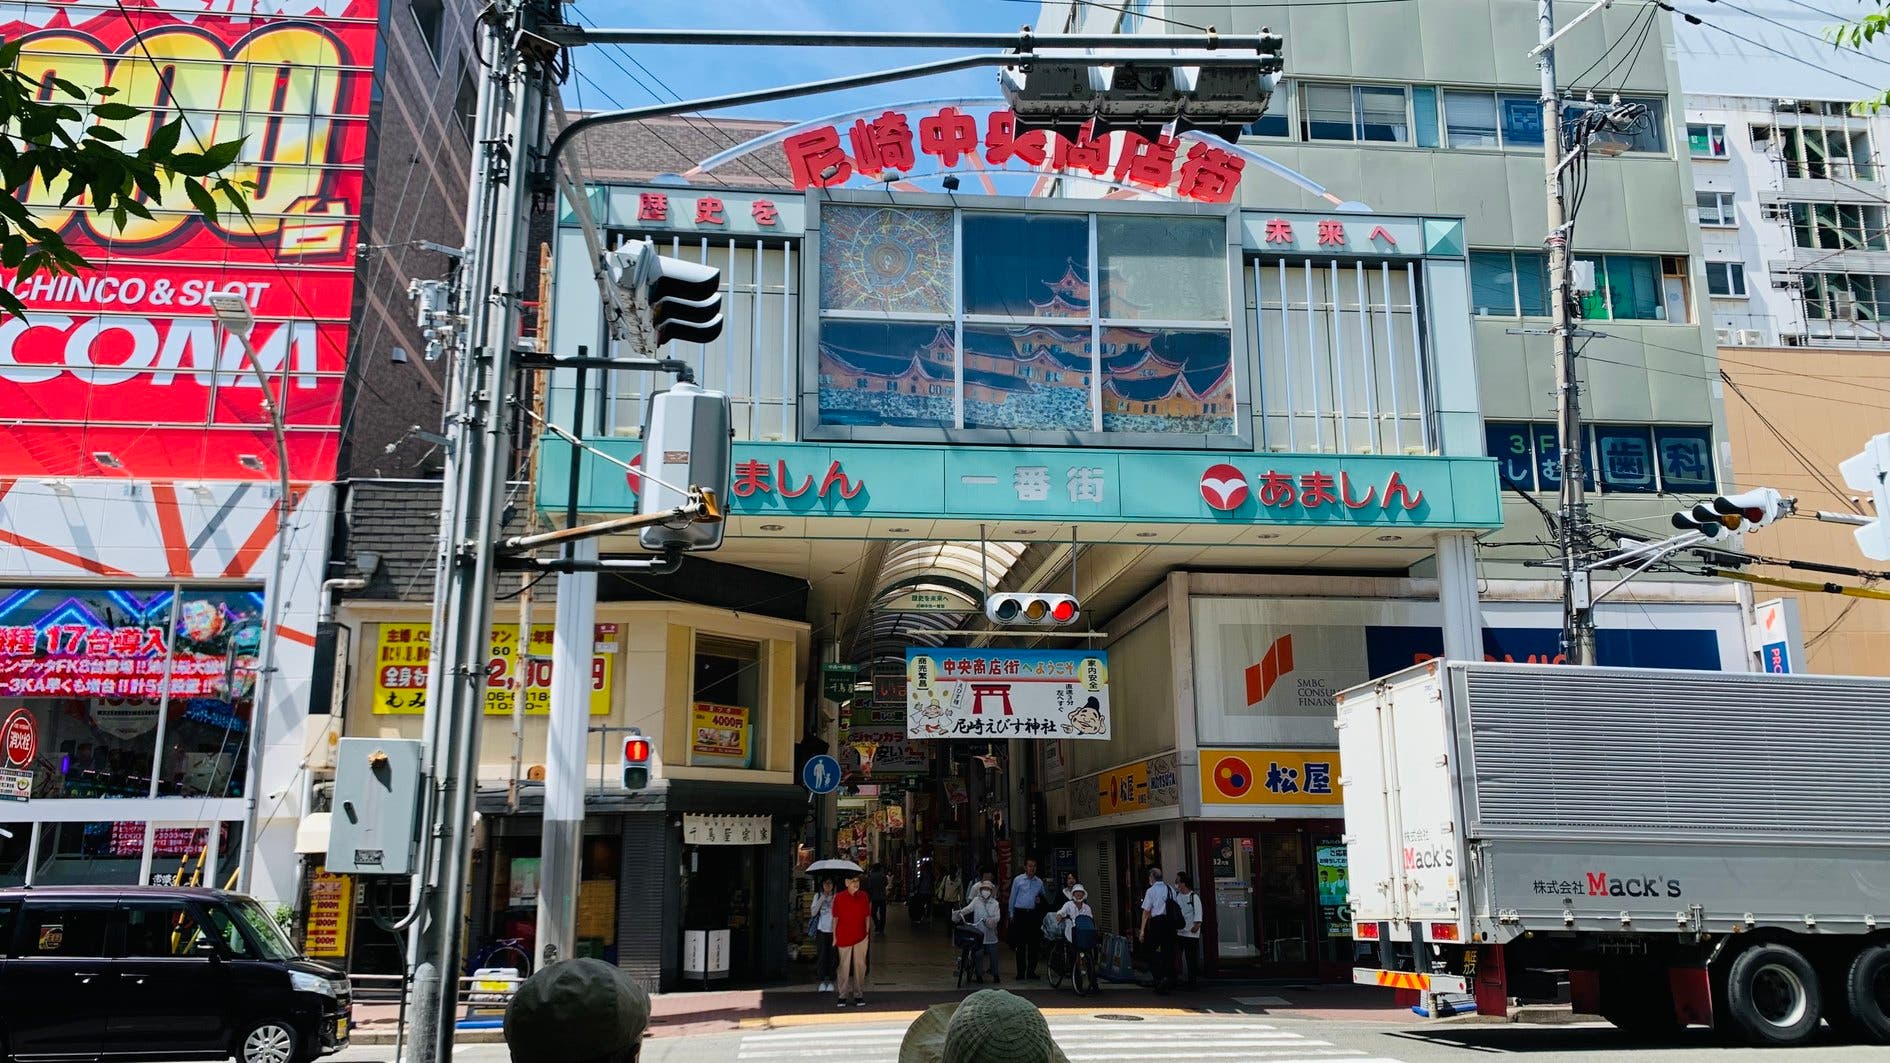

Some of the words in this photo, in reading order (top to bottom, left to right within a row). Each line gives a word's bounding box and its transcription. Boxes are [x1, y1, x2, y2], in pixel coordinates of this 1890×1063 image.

[637, 192, 778, 226] 歴史を
[1264, 217, 1397, 247] 未来へ
[0, 273, 146, 304] CHINCO
[149, 281, 174, 306] &
[1510, 434, 1555, 454] 3F
[733, 459, 864, 500] ましん
[960, 464, 1105, 503] 一番街
[1258, 469, 1423, 510] あましん
[943, 659, 1075, 676] 中央商店街へようこそ
[1087, 659, 1098, 689] 家内安全
[1297, 679, 1325, 688] SMBC
[9, 731, 30, 751] 消火栓
[952, 717, 1058, 736] 尼崎えびす神社
[1264, 761, 1333, 795] 松屋
[1403, 844, 1454, 869] Mack's
[1533, 880, 1585, 895] 株式会社
[1586, 872, 1681, 898] Mack's
